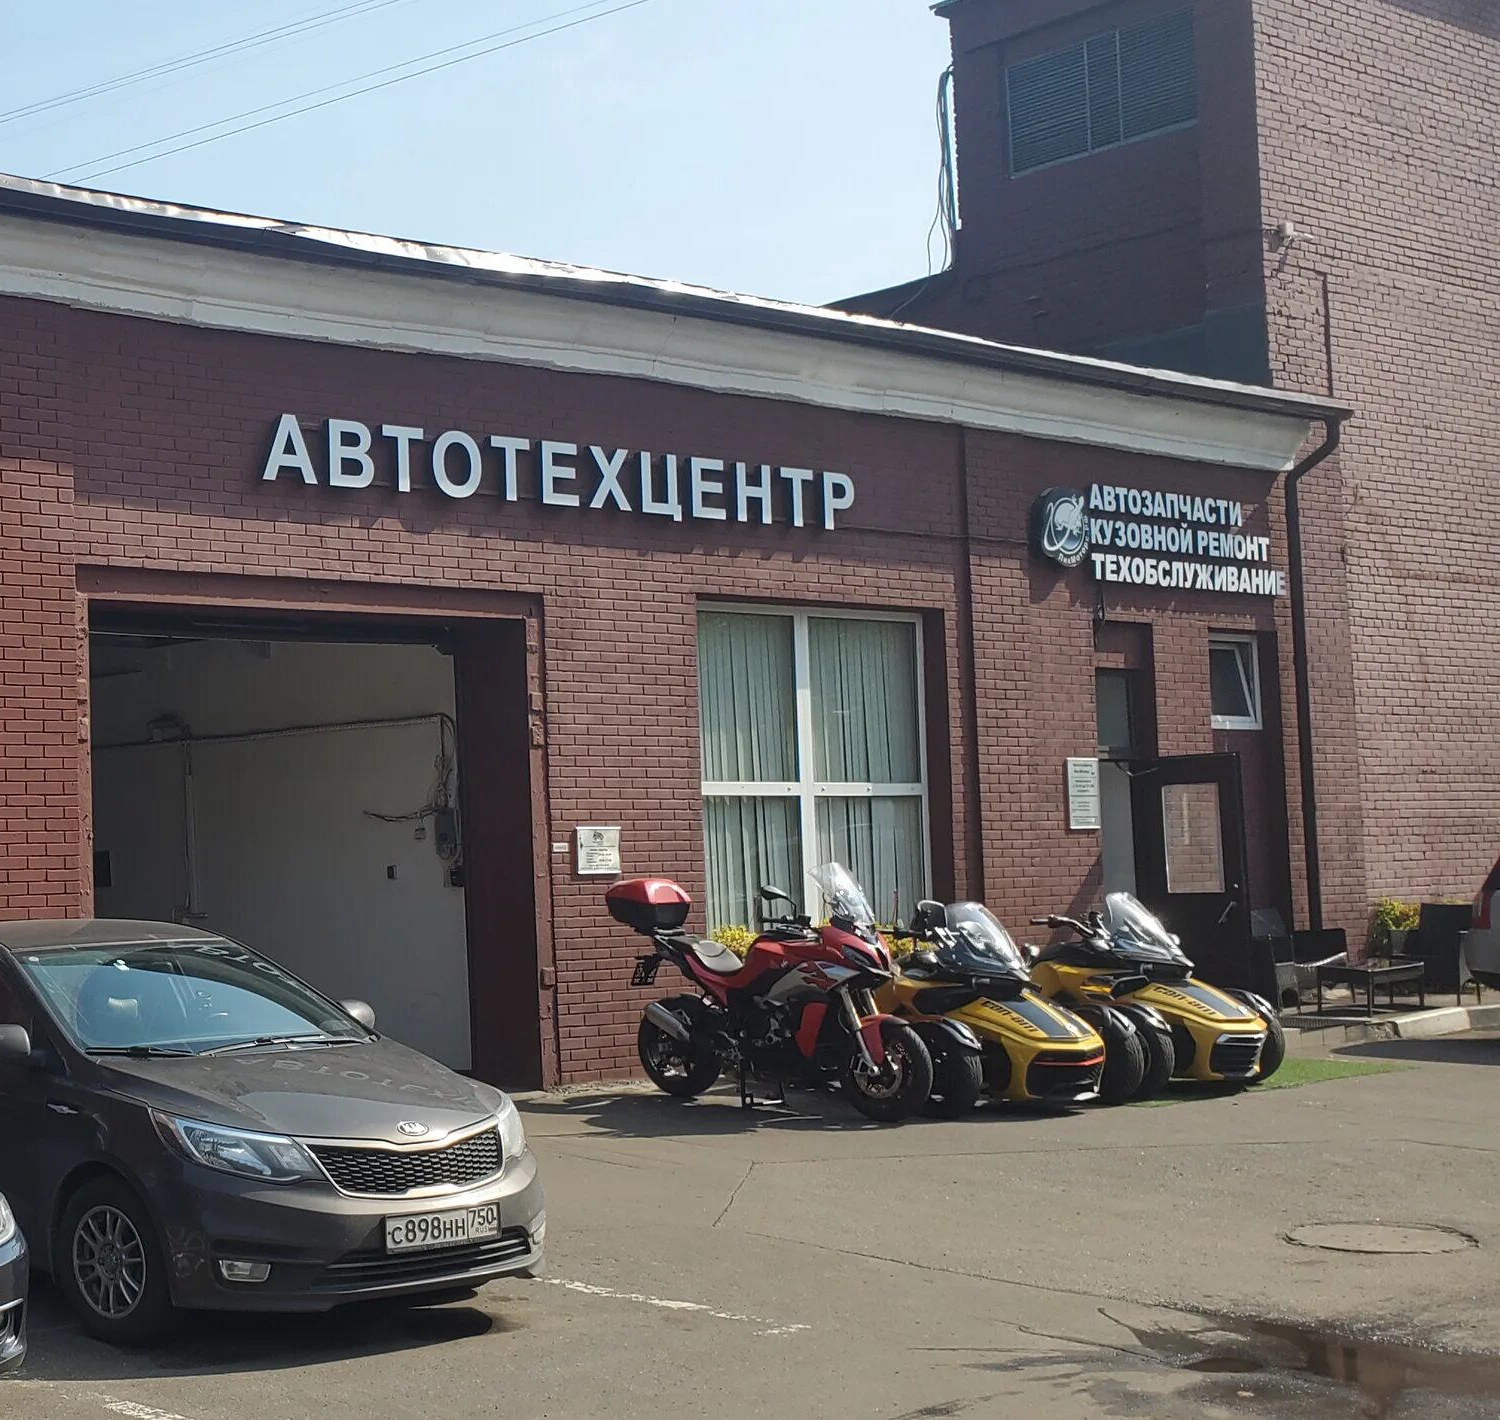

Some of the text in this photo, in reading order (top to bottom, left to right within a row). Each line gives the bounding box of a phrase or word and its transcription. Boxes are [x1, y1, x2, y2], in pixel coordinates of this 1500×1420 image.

[262, 413, 855, 530] АВТОТЕХЦЕНТР
[1089, 483, 1242, 527] АВТОЗАПЧАСТИ
[1090, 518, 1269, 562] КУЗОВНОЙ РЕМОНТ
[1091, 553, 1286, 596] ТЕХОБСЛУЖИВАНИЕ
[391, 1207, 495, 1244] С898НН 750
[475, 1225, 489, 1233] RUS
